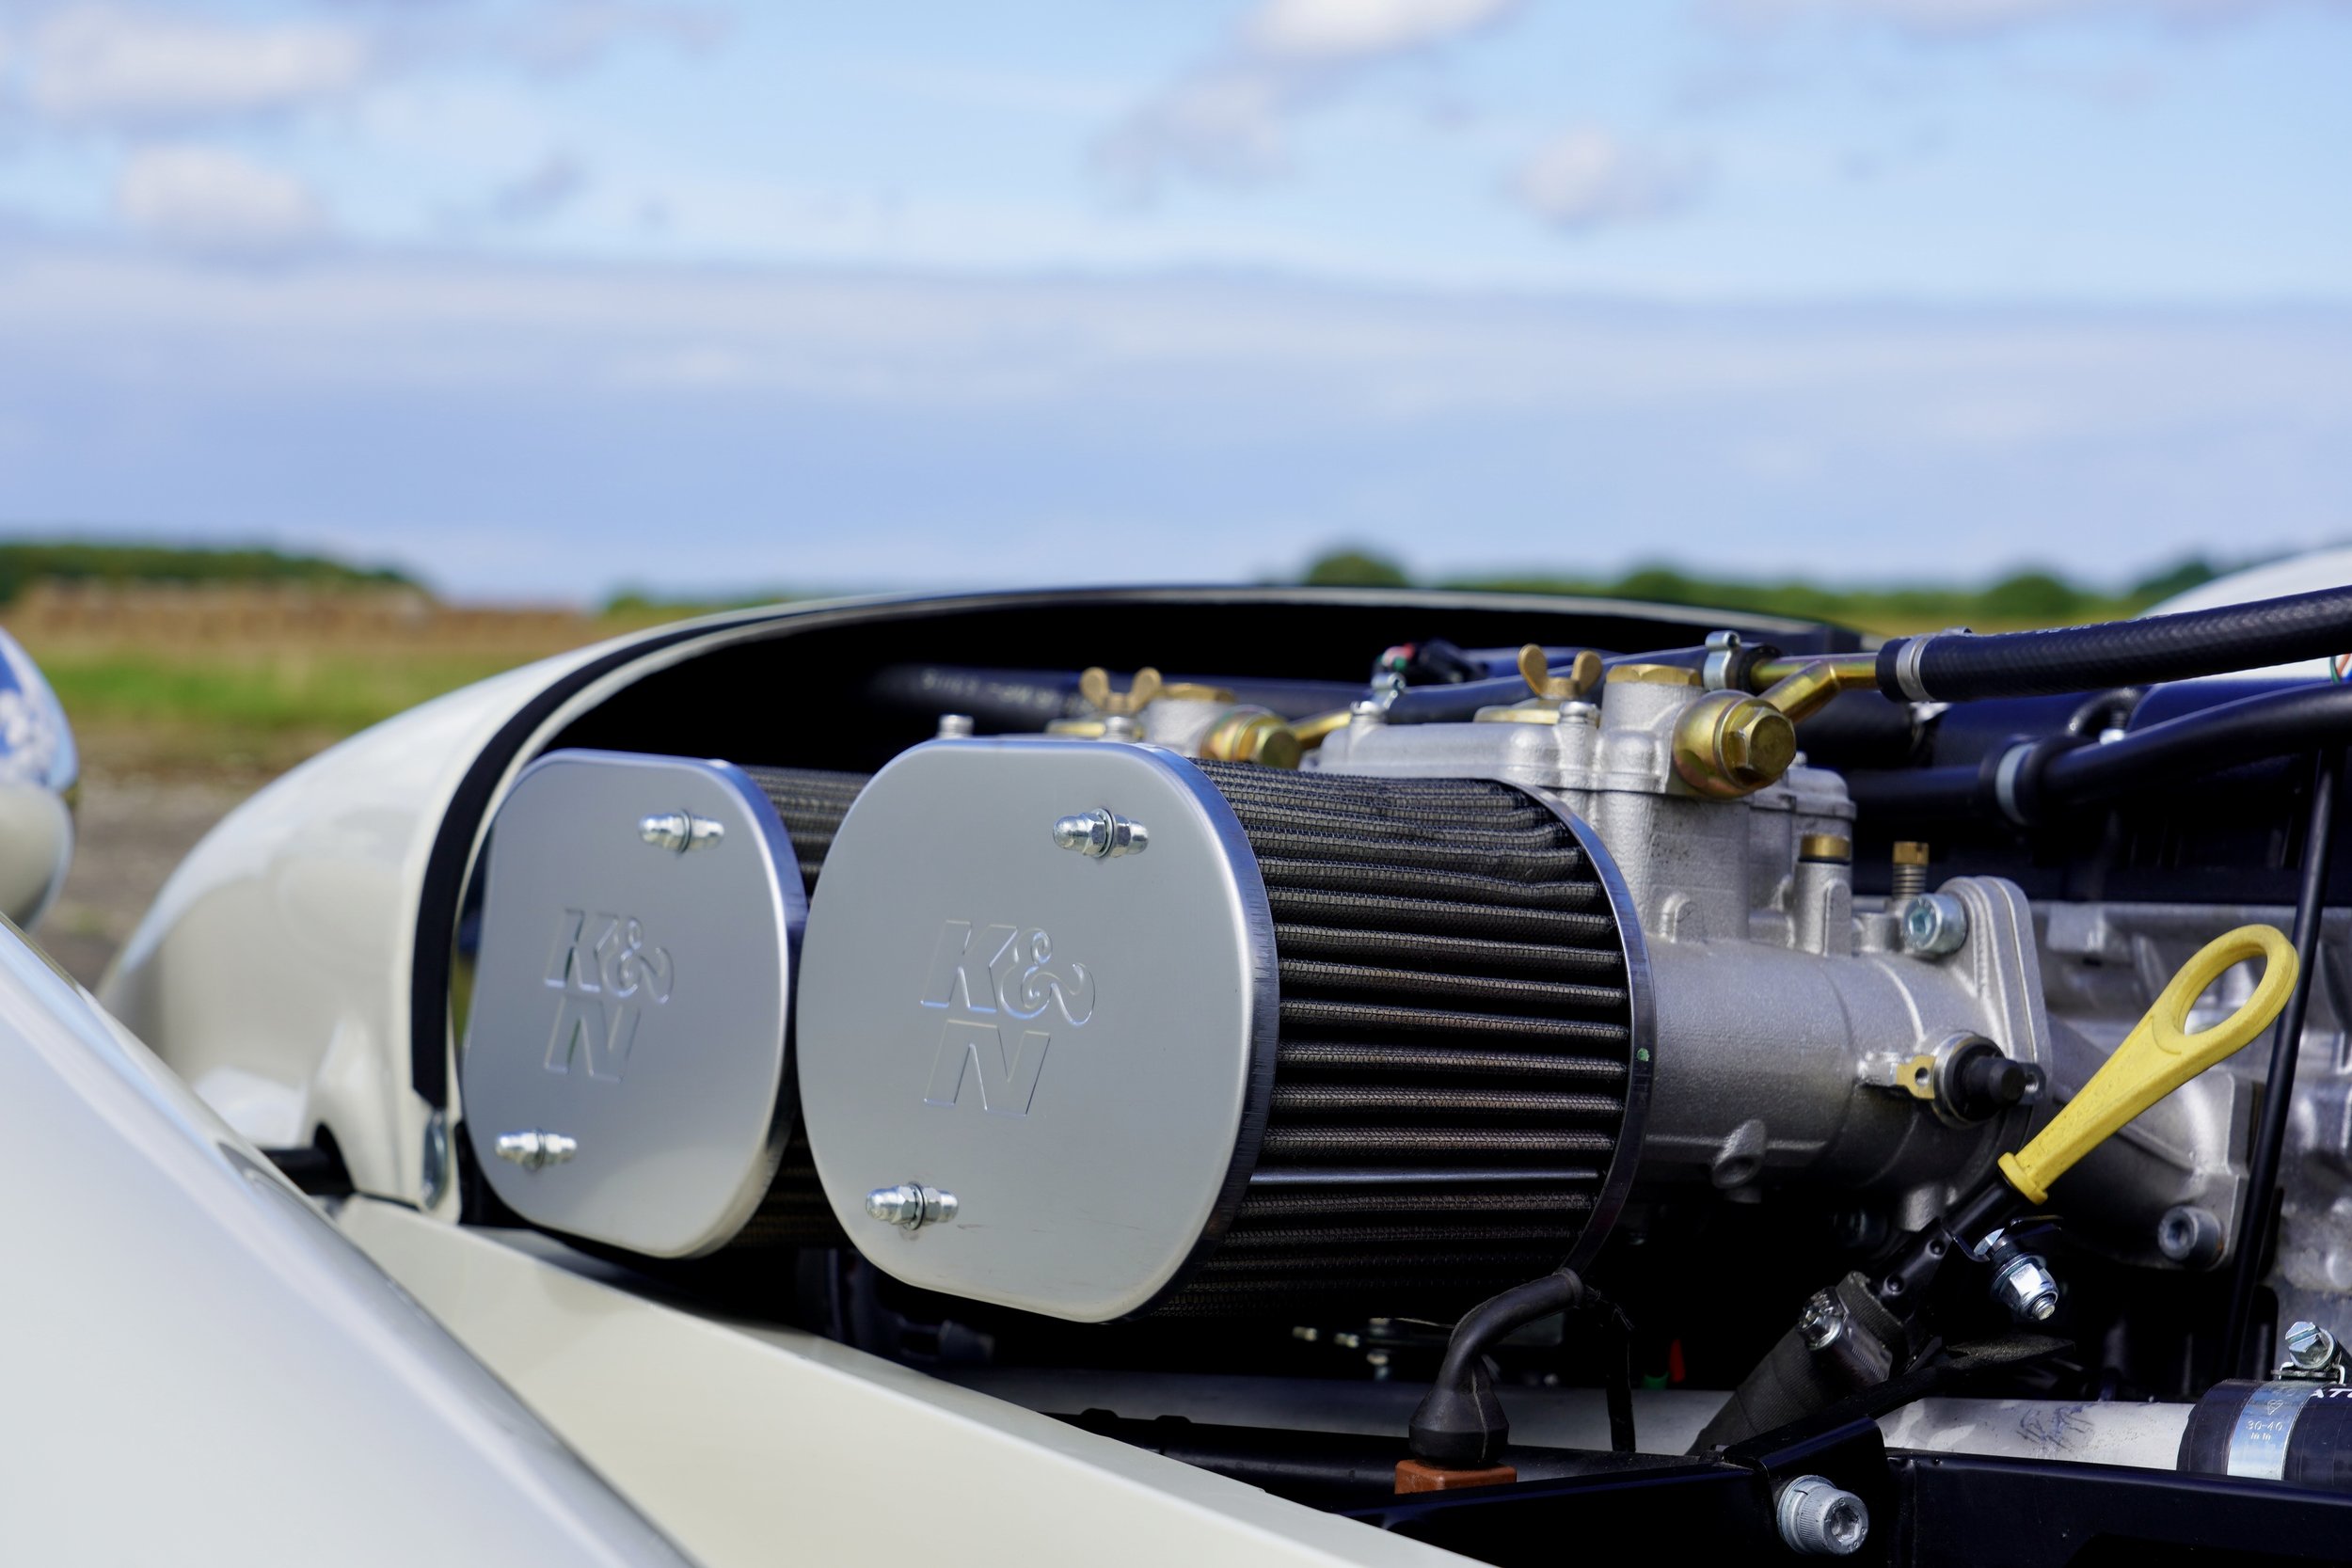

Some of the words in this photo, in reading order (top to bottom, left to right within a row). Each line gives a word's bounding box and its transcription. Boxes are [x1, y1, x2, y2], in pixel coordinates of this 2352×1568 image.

[544, 908, 675, 1005] K&
[920, 919, 1095, 1025] K&
[544, 994, 642, 1082] N
[923, 1019, 1051, 1117] N
[2246, 1419, 2284, 1433] 30-40
